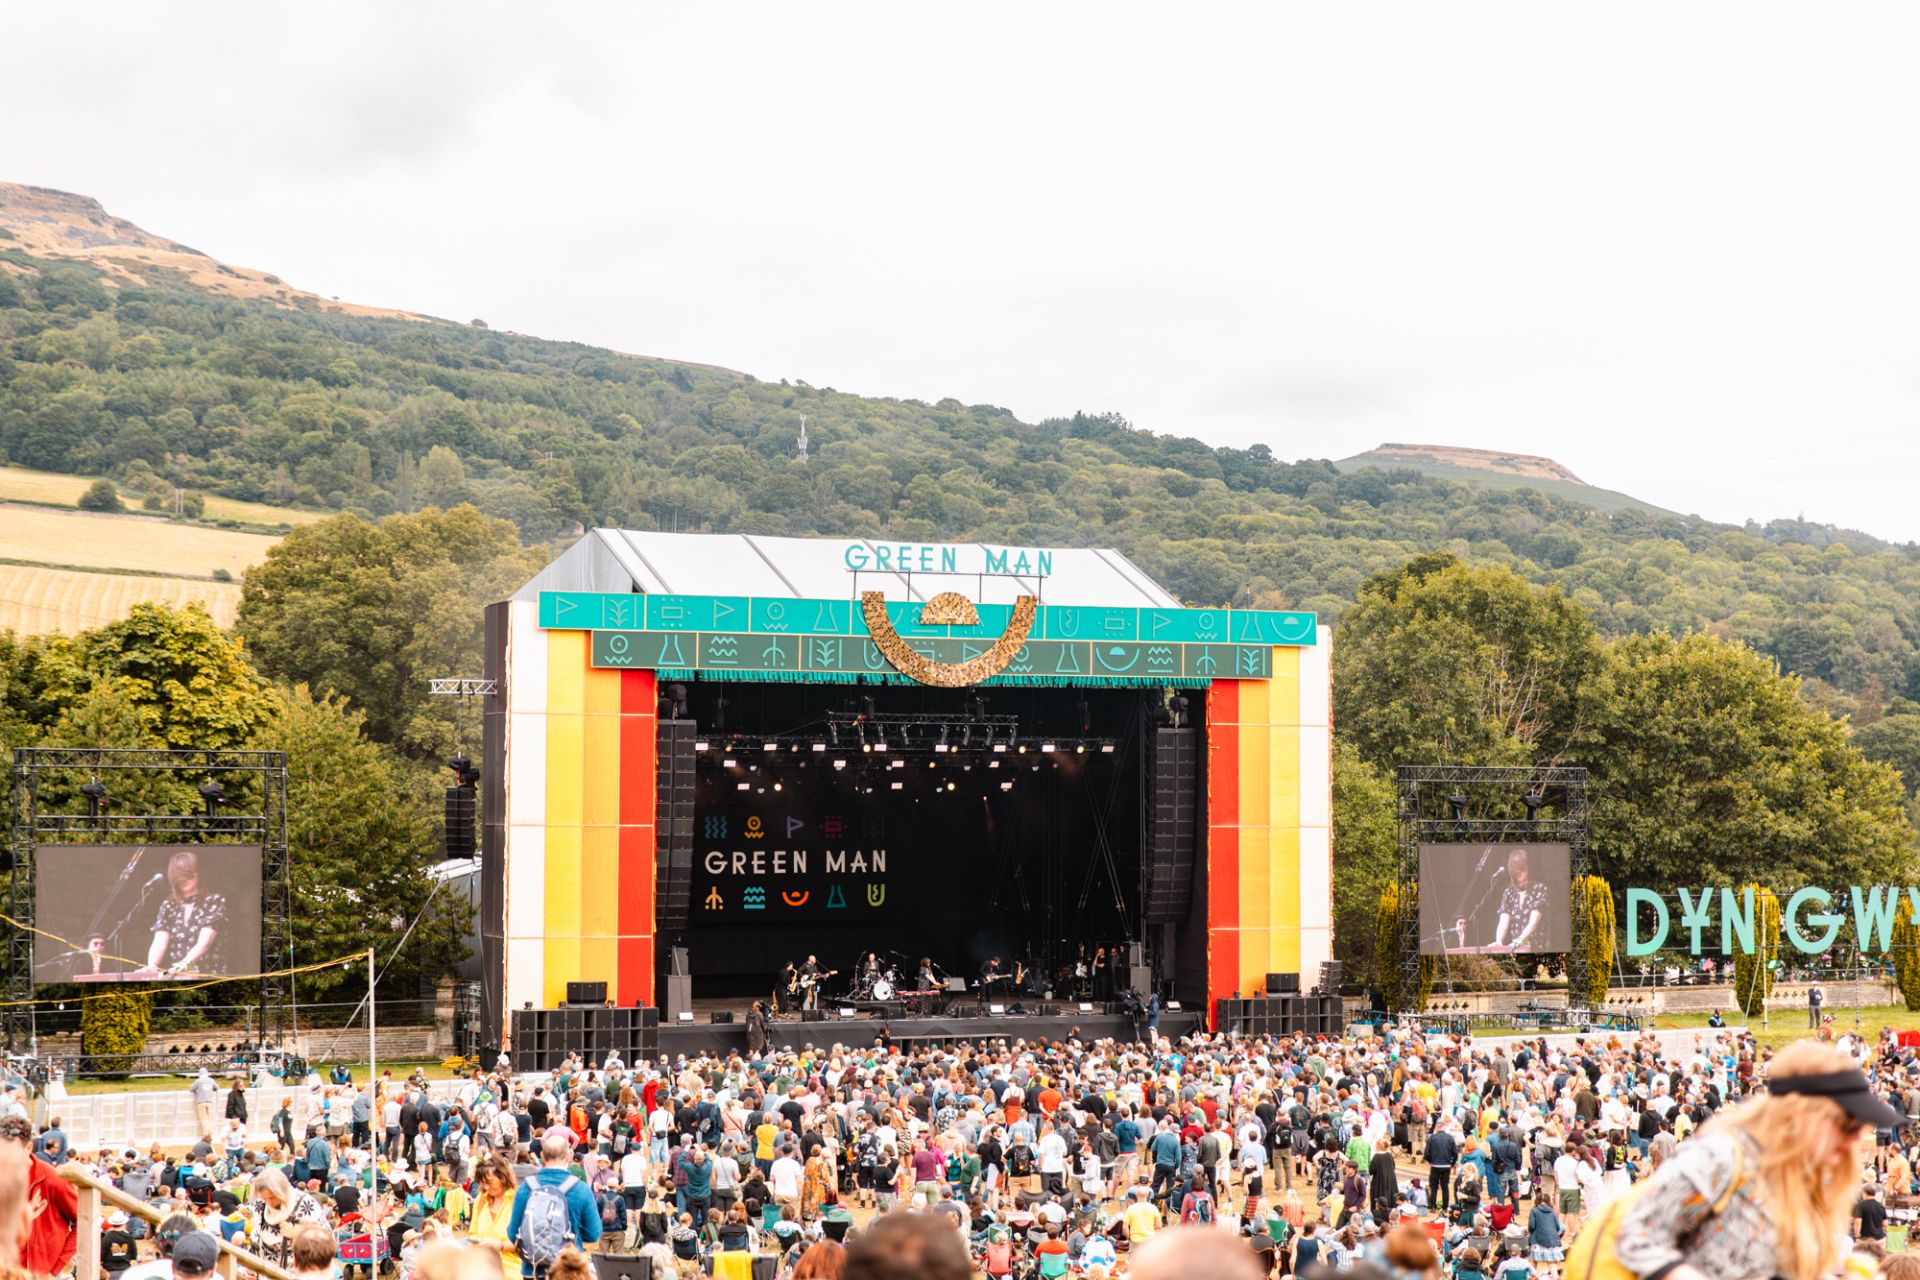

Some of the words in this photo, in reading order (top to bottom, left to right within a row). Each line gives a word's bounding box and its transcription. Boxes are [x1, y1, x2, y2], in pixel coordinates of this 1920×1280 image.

[845, 545, 956, 571] GREEN
[985, 549, 1052, 575] MAN
[705, 851, 807, 875] GREEN
[826, 850, 886, 873] MAN
[1626, 887, 1755, 956] DYN
